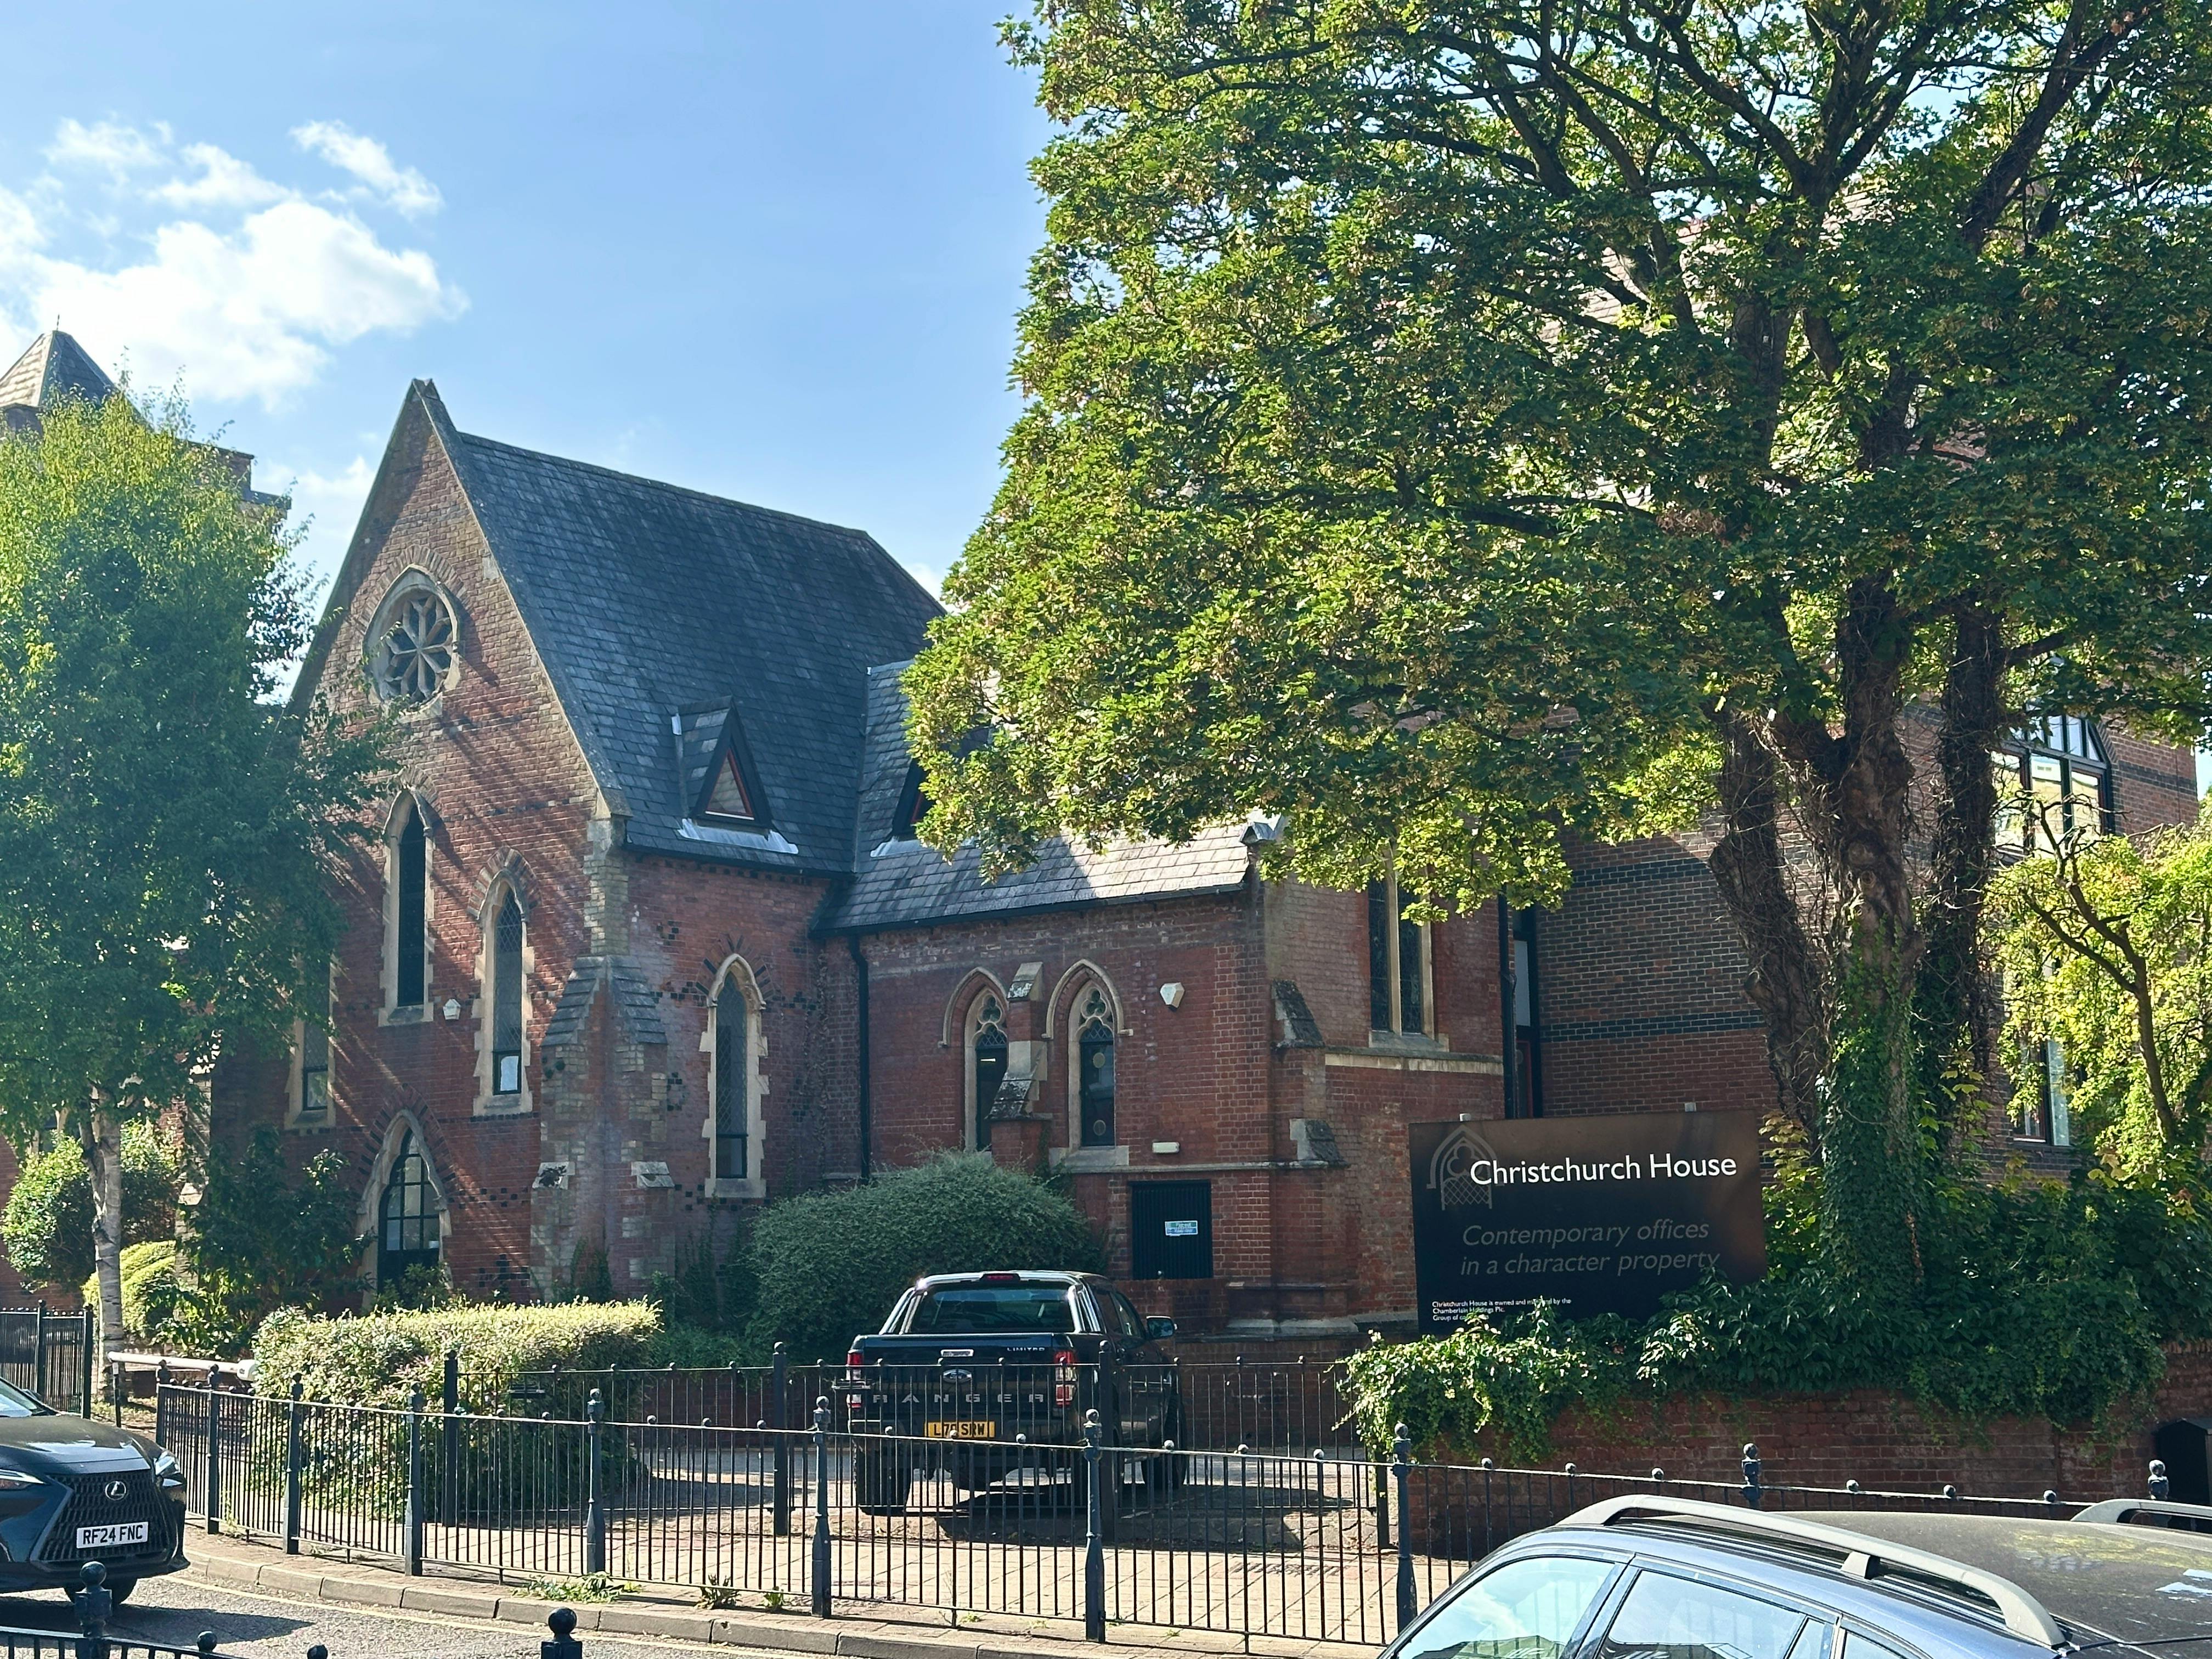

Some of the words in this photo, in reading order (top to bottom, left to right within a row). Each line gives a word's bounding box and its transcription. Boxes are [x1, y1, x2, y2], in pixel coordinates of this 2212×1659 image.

[1470, 1154, 1641, 1186] Christchurch
[1649, 1153, 1737, 1178] House
[1463, 1225, 1630, 1249] Contemporary
[1637, 1219, 1709, 1240] offices
[1461, 1256, 1479, 1276] in
[1486, 1260, 1498, 1275] a
[1505, 1253, 1610, 1273] character
[1617, 1252, 1720, 1277] property
[873, 1393, 1043, 1403] RANGER
[83, 1527, 116, 1544] RF24
[119, 1525, 143, 1541] FNC
